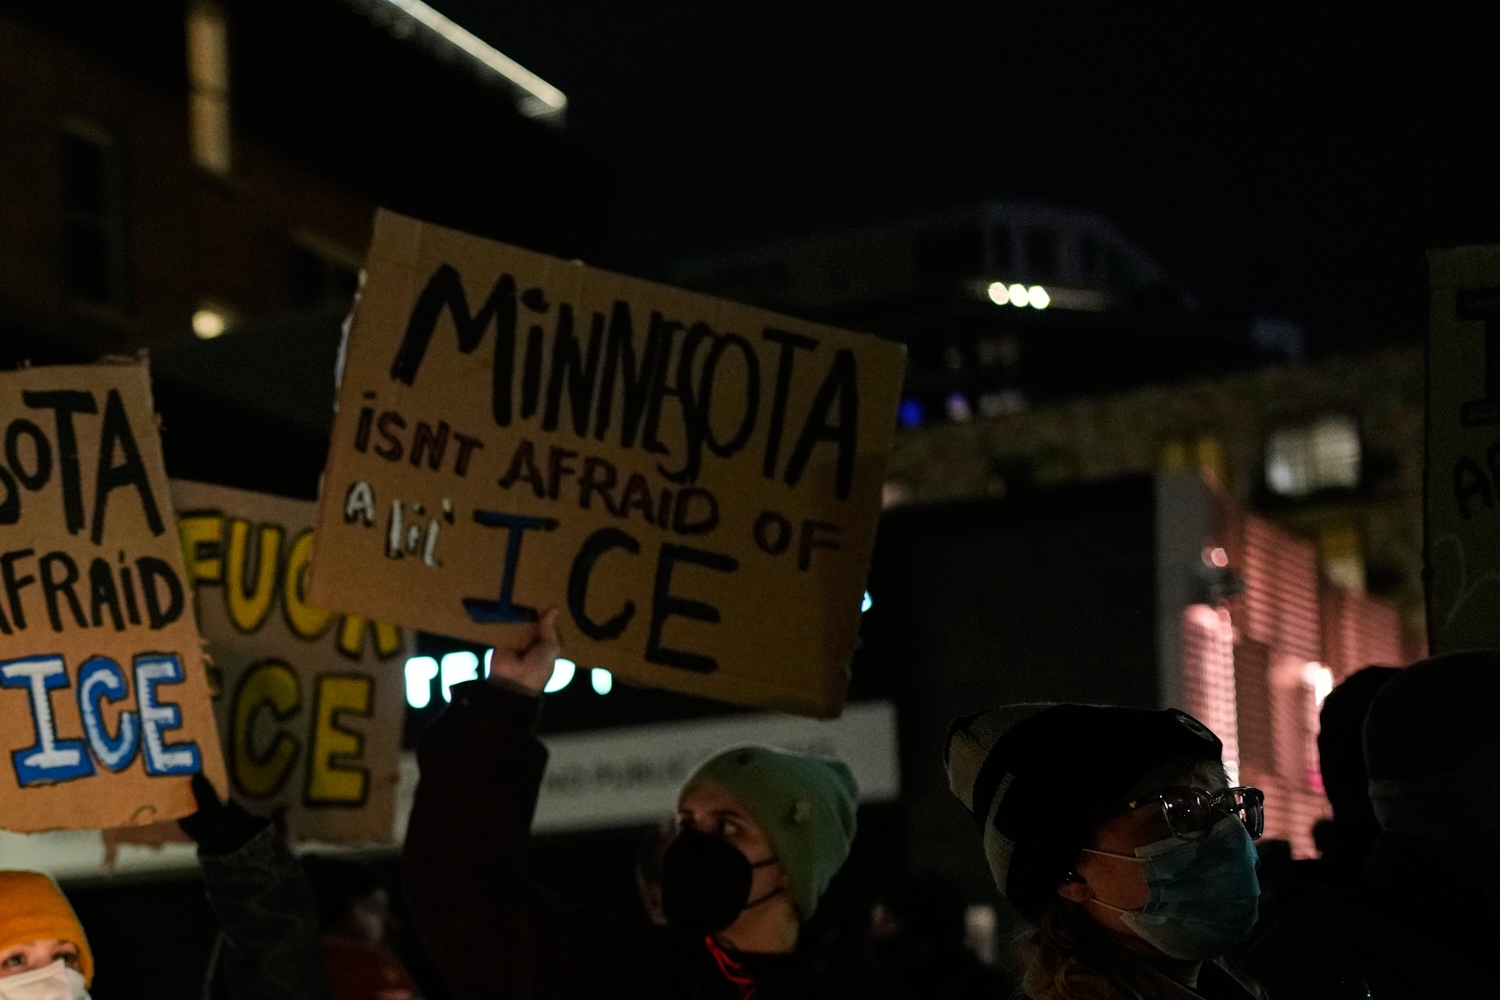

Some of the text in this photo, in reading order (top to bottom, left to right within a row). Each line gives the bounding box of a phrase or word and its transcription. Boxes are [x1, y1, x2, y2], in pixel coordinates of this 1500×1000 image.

[344, 479, 376, 528] A
[462, 509, 740, 674] ICE
[498, 438, 720, 535] AFRAID
[752, 510, 841, 572] OF
[178, 507, 403, 659] FUC
[203, 660, 374, 808] CE
